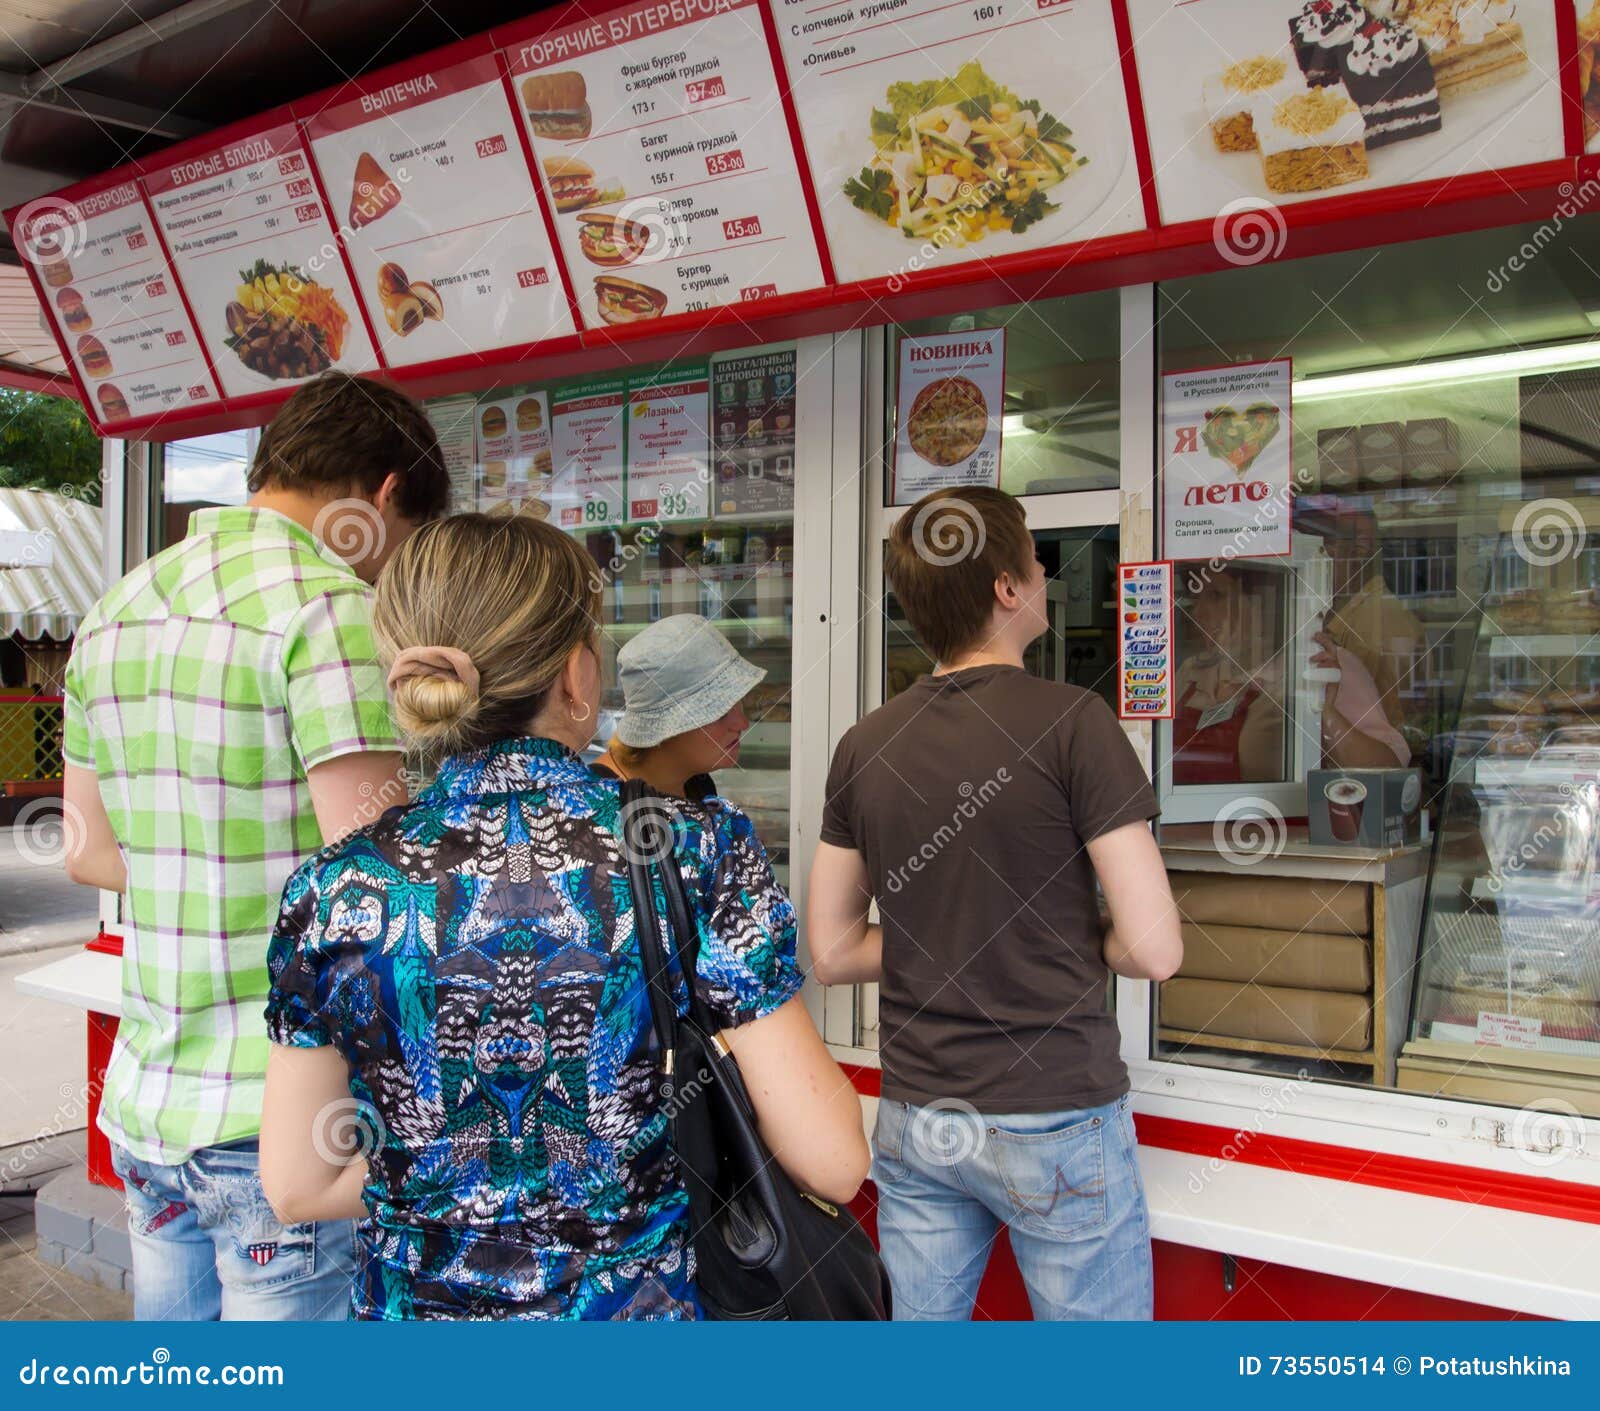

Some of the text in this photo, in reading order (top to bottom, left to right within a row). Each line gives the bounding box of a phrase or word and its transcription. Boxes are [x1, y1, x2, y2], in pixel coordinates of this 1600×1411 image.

[791, 0, 908, 37] С копченой курицей
[972, 5, 1003, 22] 160 г
[520, 0, 742, 68] ГОРЯЧИЕ БУТЕРБРОД
[620, 50, 687, 77] Фреш бургер
[801, 44, 857, 68] «Оливье»
[625, 56, 720, 92] с жареной грудкой
[361, 73, 439, 113] ВЫПЕЧКА
[686, 82, 724, 103] 37-00
[631, 100, 656, 116] 173 г
[476, 140, 507, 158] 26-00
[640, 133, 668, 148] Багет
[645, 131, 738, 162] с куриной грудкой
[389, 139, 447, 163] Самса с мясом
[170, 155, 225, 185] ВТОРЫЕ
[224, 139, 275, 169] БЛЮДА
[435, 155, 455, 167] 140 г
[707, 155, 743, 174] 35-00
[650, 171, 675, 186] 155 г
[658, 196, 694, 213] Бургер
[670, 206, 719, 225] окороком
[725, 220, 761, 240] 45-00
[667, 235, 693, 249] 210 г
[470, 268, 491, 279] тесте
[519, 271, 548, 288] 19-00
[676, 263, 712, 279] Бургер
[476, 285, 488, 295] 90
[681, 273, 730, 293] с курицей
[685, 300, 704, 314] 210
[909, 341, 993, 362] НОВИНКА
[718, 352, 792, 373] НАТУРАЛЬНЫЙ
[714, 367, 765, 384] ЗЕРНОВОЙ
[1174, 369, 1279, 389] Сезонные предложения
[1183, 390, 1189, 398] в
[1191, 386, 1227, 398] Русском
[643, 405, 685, 419] Лазанья
[1173, 426, 1198, 454] Я
[585, 501, 608, 523] 89
[1175, 519, 1214, 529] Окрошка,
[1175, 528, 1201, 537] Салат
[1202, 528, 1213, 536] из
[1139, 568, 1162, 577] Orbit
[1139, 583, 1162, 591] Orbit
[1139, 597, 1162, 605] Orbit
[1139, 612, 1162, 621] Orbit
[1134, 627, 1159, 637] Orbit
[1134, 642, 1160, 652] Orbit
[1133, 657, 1159, 667] Orbit
[1132, 671, 1158, 681] Orbit
[1134, 686, 1160, 696] Orbit
[1132, 701, 1159, 711] Orbit
